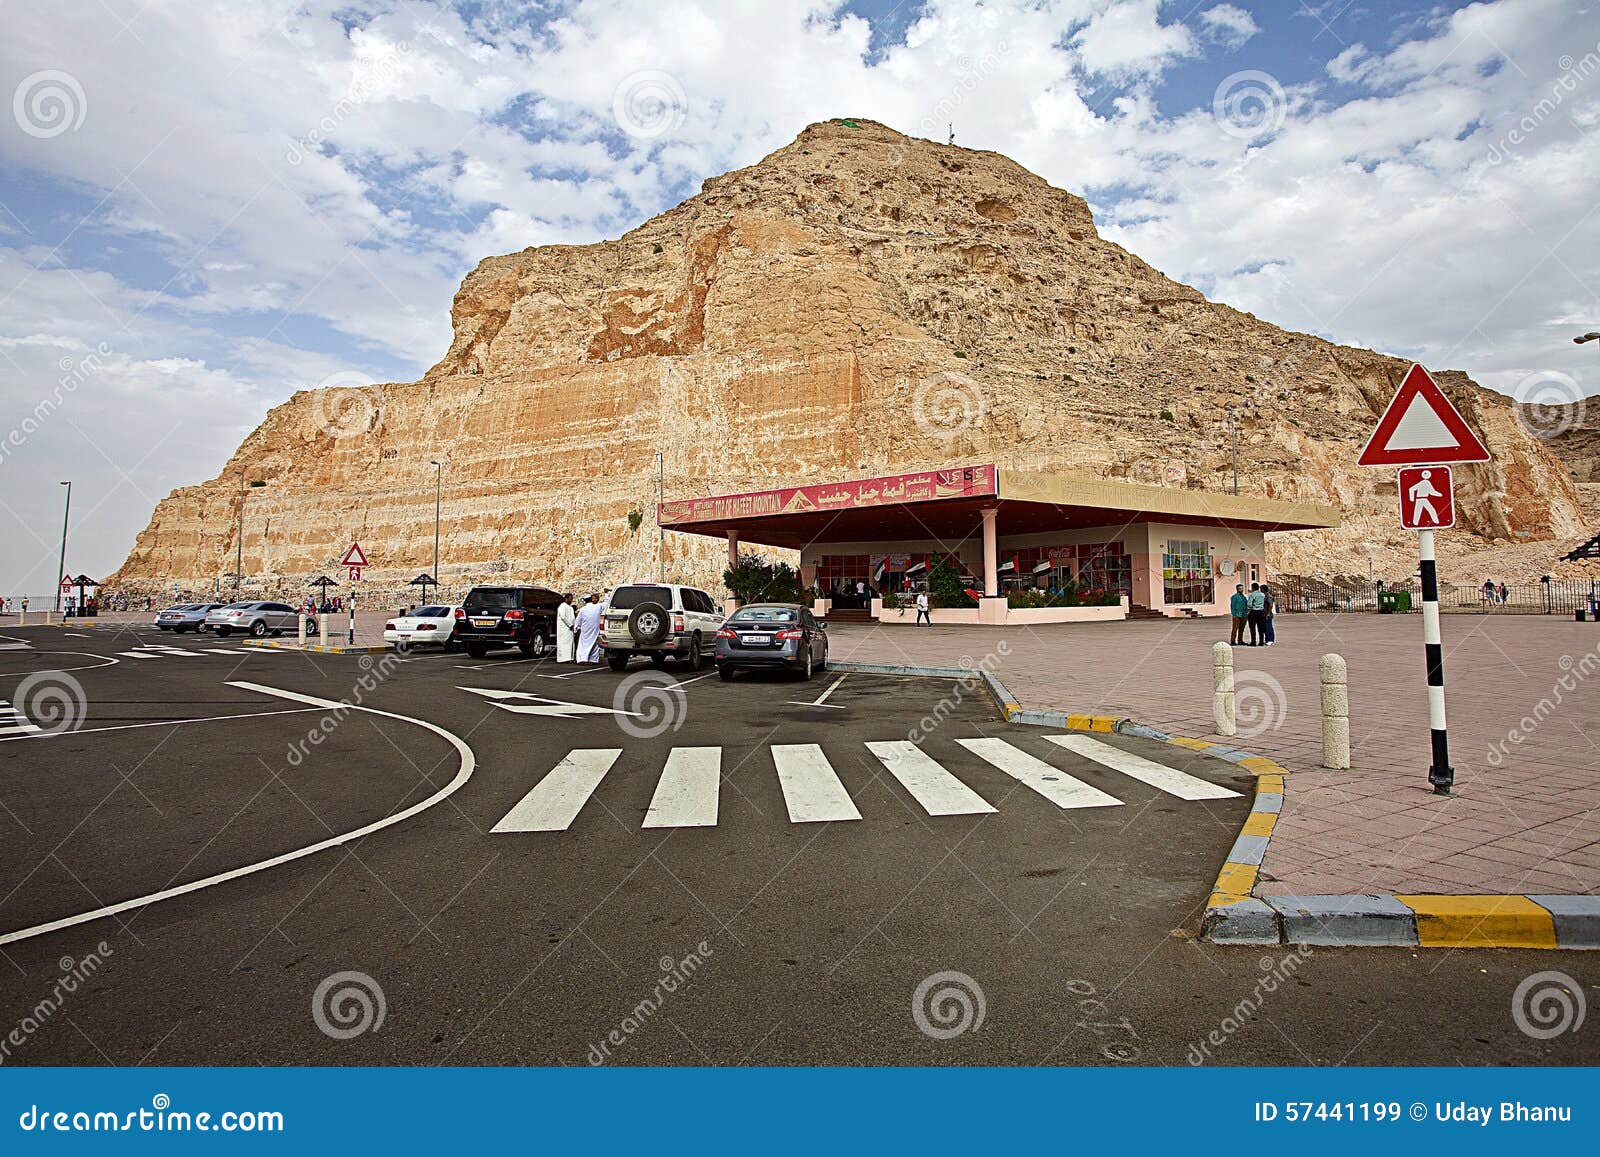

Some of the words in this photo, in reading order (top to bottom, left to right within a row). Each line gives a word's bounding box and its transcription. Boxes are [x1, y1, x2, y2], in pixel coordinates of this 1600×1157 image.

[817, 487, 852, 508] حفيت
[853, 484, 880, 506] جبل
[881, 477, 905, 498] قمة
